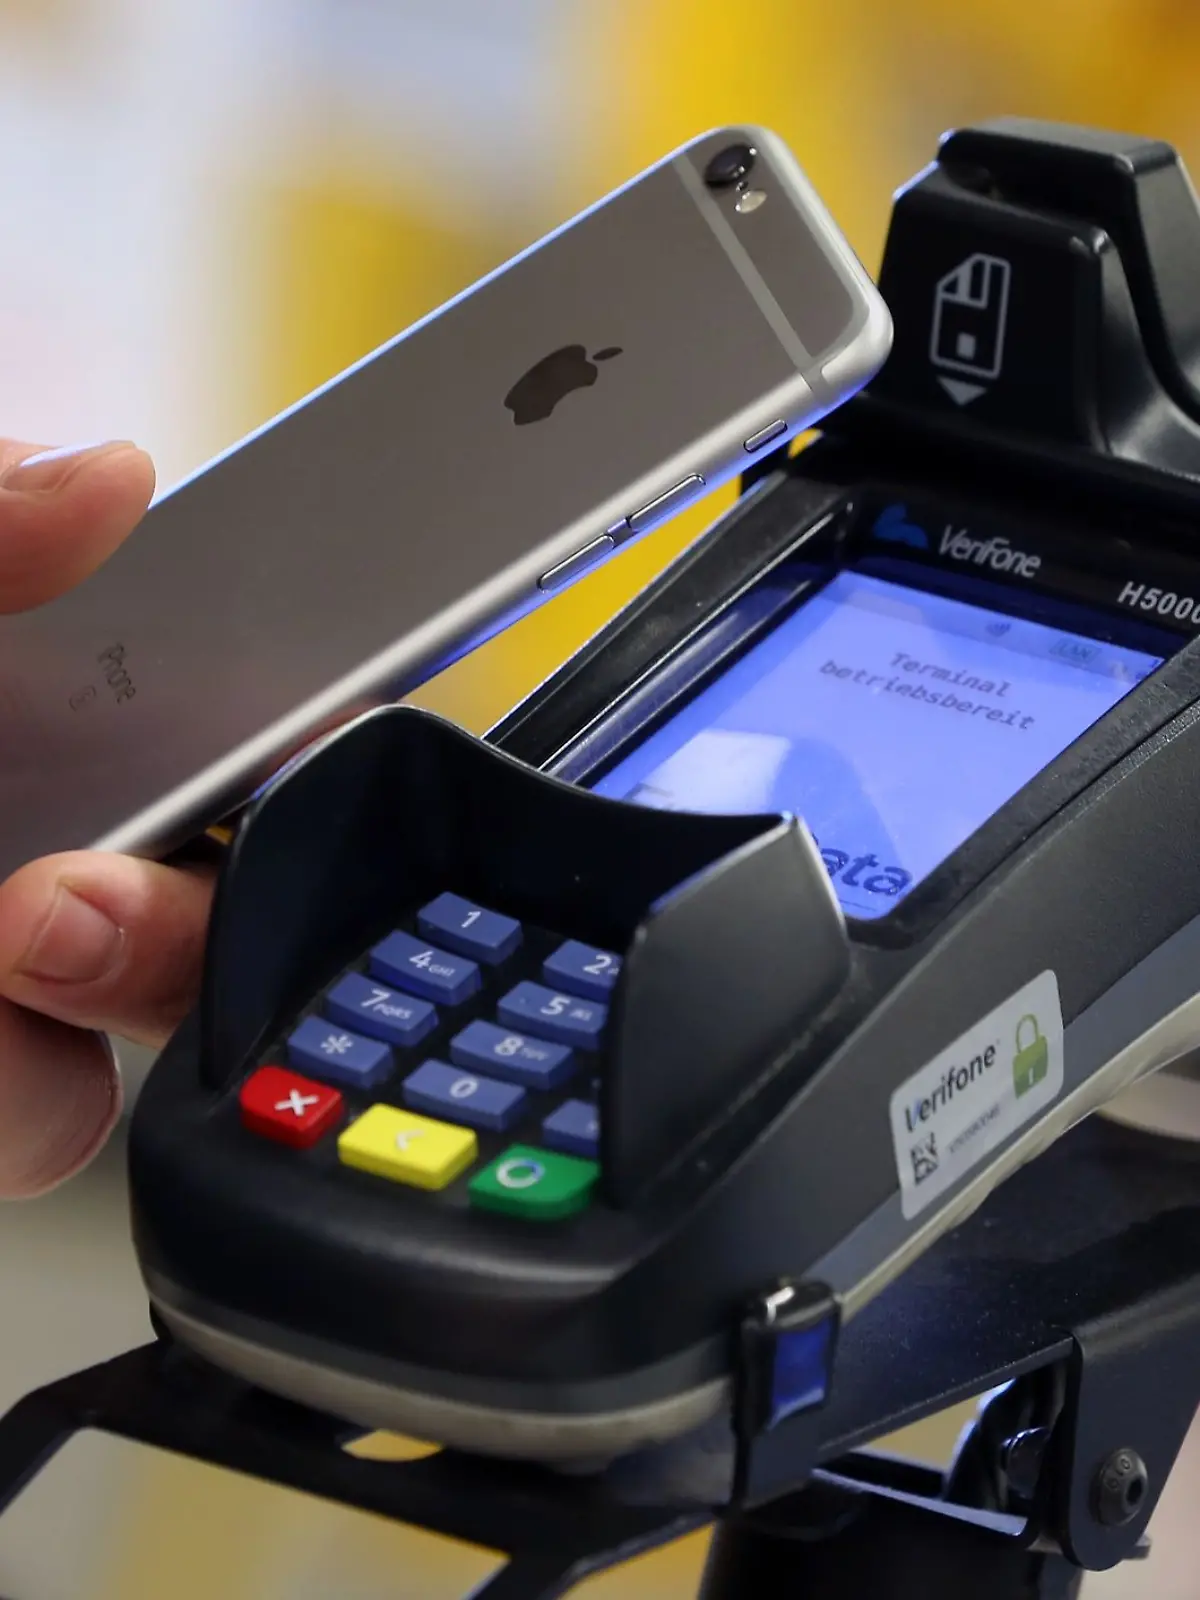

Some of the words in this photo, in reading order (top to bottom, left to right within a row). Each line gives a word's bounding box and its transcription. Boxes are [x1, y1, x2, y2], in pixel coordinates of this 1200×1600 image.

[889, 652, 1012, 697] Terminal
[819, 660, 1035, 730] betriebsbereit
[461, 910, 481, 928] 1
[540, 997, 570, 1016] 5
[494, 1037, 523, 1056] 8
[449, 1078, 478, 1098] 0
[905, 1044, 996, 1132] Verifone
